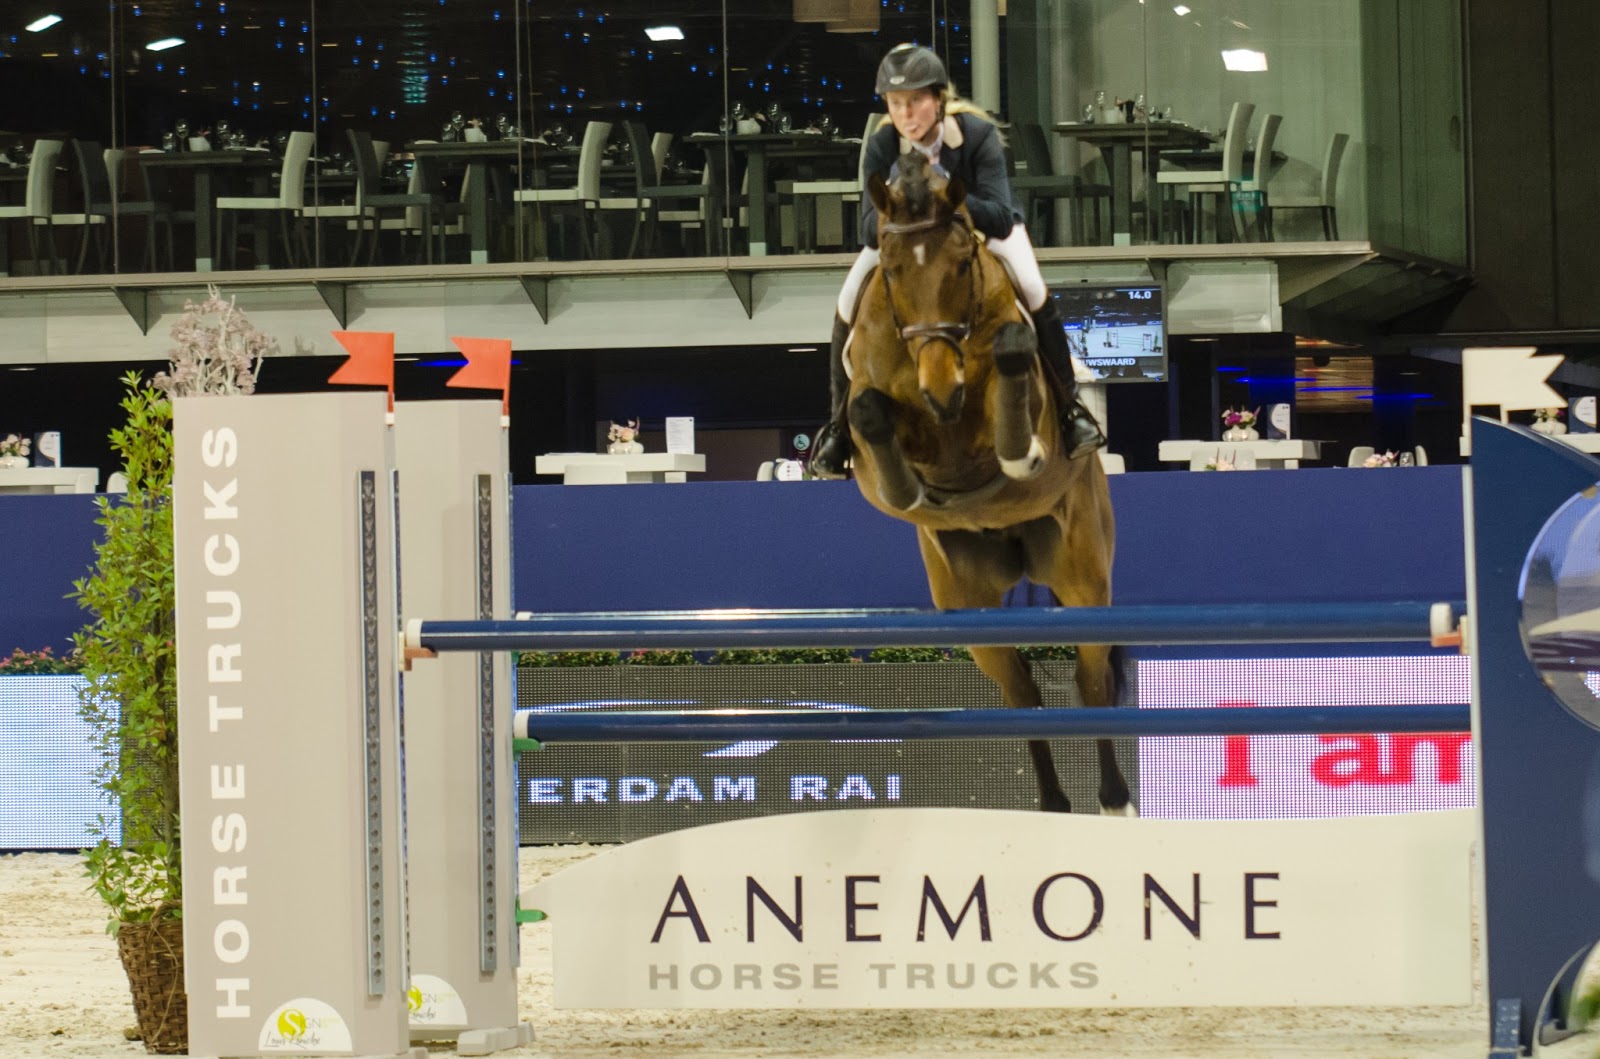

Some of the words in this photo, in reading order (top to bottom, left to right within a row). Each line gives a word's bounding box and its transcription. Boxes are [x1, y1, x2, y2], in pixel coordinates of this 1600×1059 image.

[1128, 291, 1152, 300] 14.0
[201, 426, 244, 733] TRUCKS
[789, 773, 902, 801] RAI
[210, 764, 251, 1019] HORSE
[650, 871, 1281, 944] ANEMONE
[648, 963, 839, 990] HORSE
[870, 961, 1100, 990] TRUCKS
